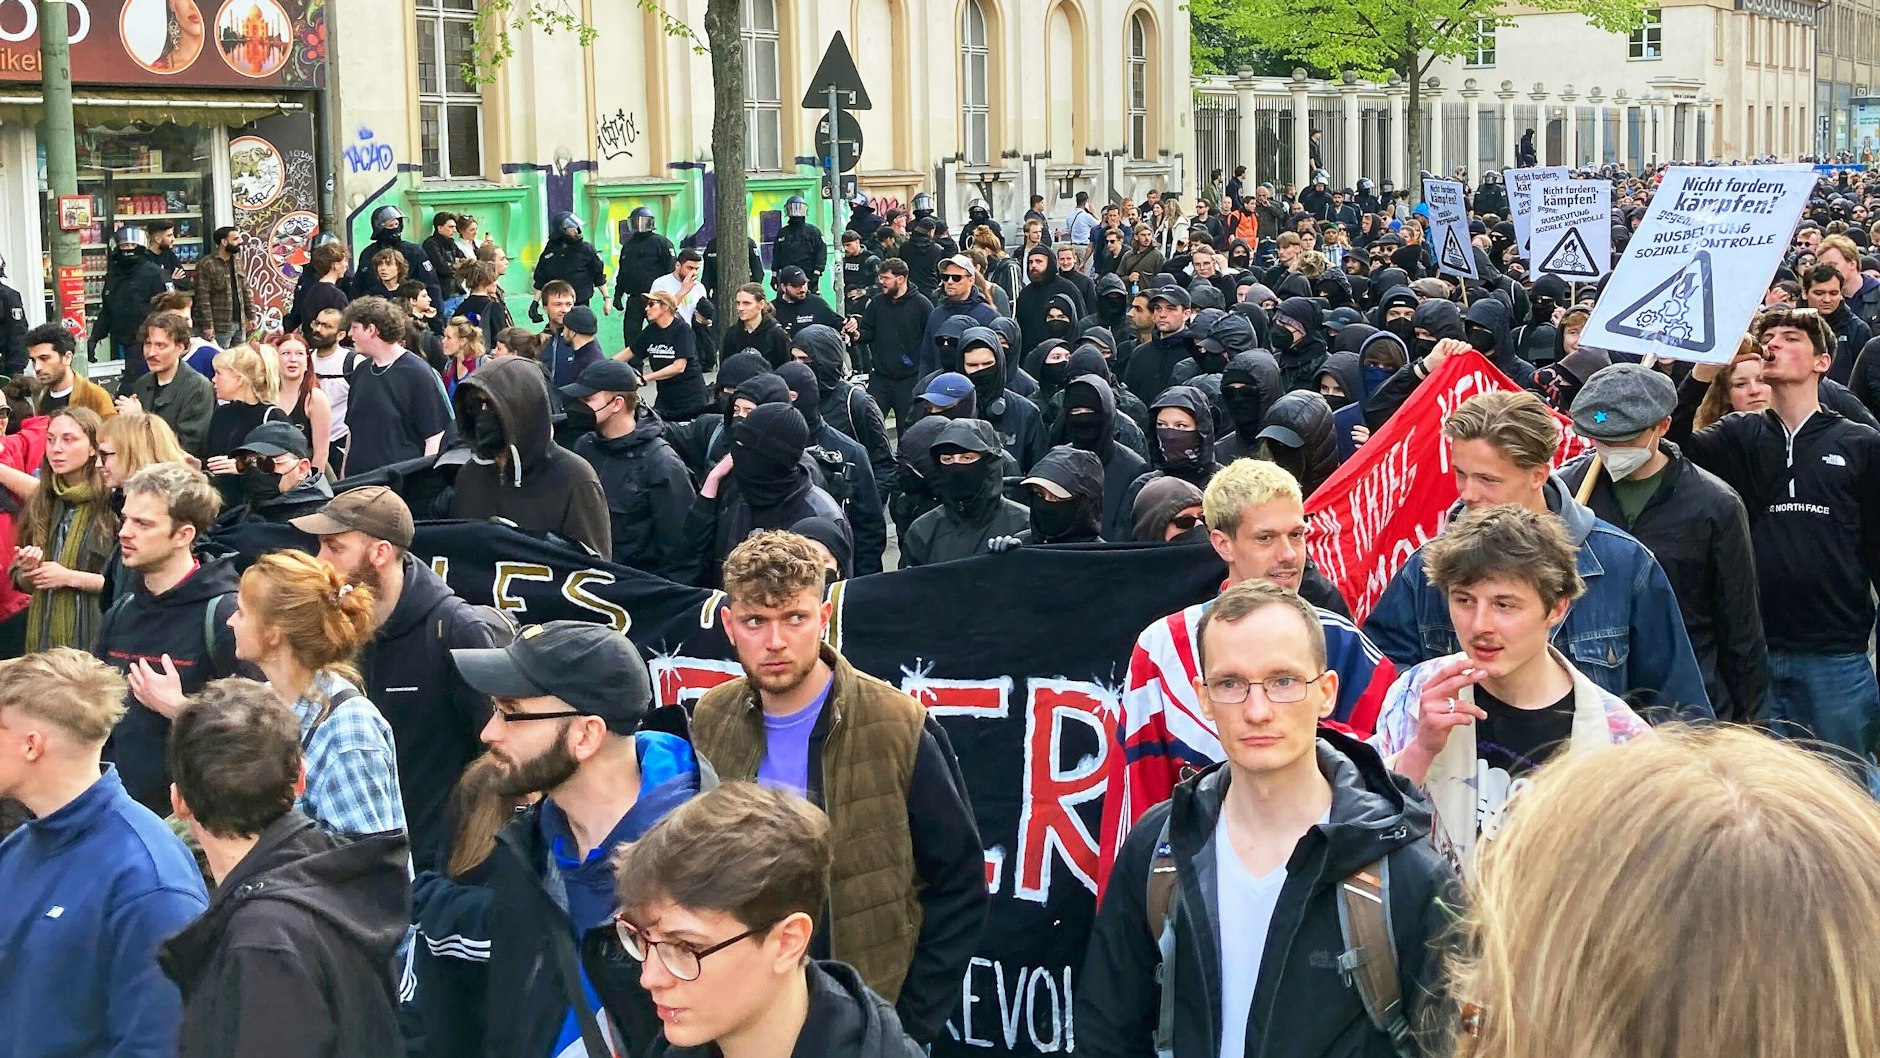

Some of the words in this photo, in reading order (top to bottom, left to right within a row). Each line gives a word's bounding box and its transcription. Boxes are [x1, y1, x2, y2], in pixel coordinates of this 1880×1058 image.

[1514, 173, 1531, 182] Nicht
[1543, 186, 1563, 195] Nicht
[1565, 184, 1599, 194] fordern,
[1682, 176, 1723, 192] Nicht
[1725, 177, 1788, 197] fordern,
[1543, 193, 1597, 208] kämpfen!
[1673, 191, 1779, 216] kämpfen!
[1535, 222, 1563, 234] SOZIALE
[1564, 213, 1605, 227] KONTROLLE
[1541, 208, 1590, 225] AUSBEUTUNG
[1634, 243, 1692, 259] SOZIALE
[1693, 233, 1777, 250] ONTROLLE
[845, 263, 860, 271] PRESS
[1775, 502, 1805, 512] NORTH
[1805, 503, 1830, 515] FACE
[945, 956, 1076, 1054] EVO
